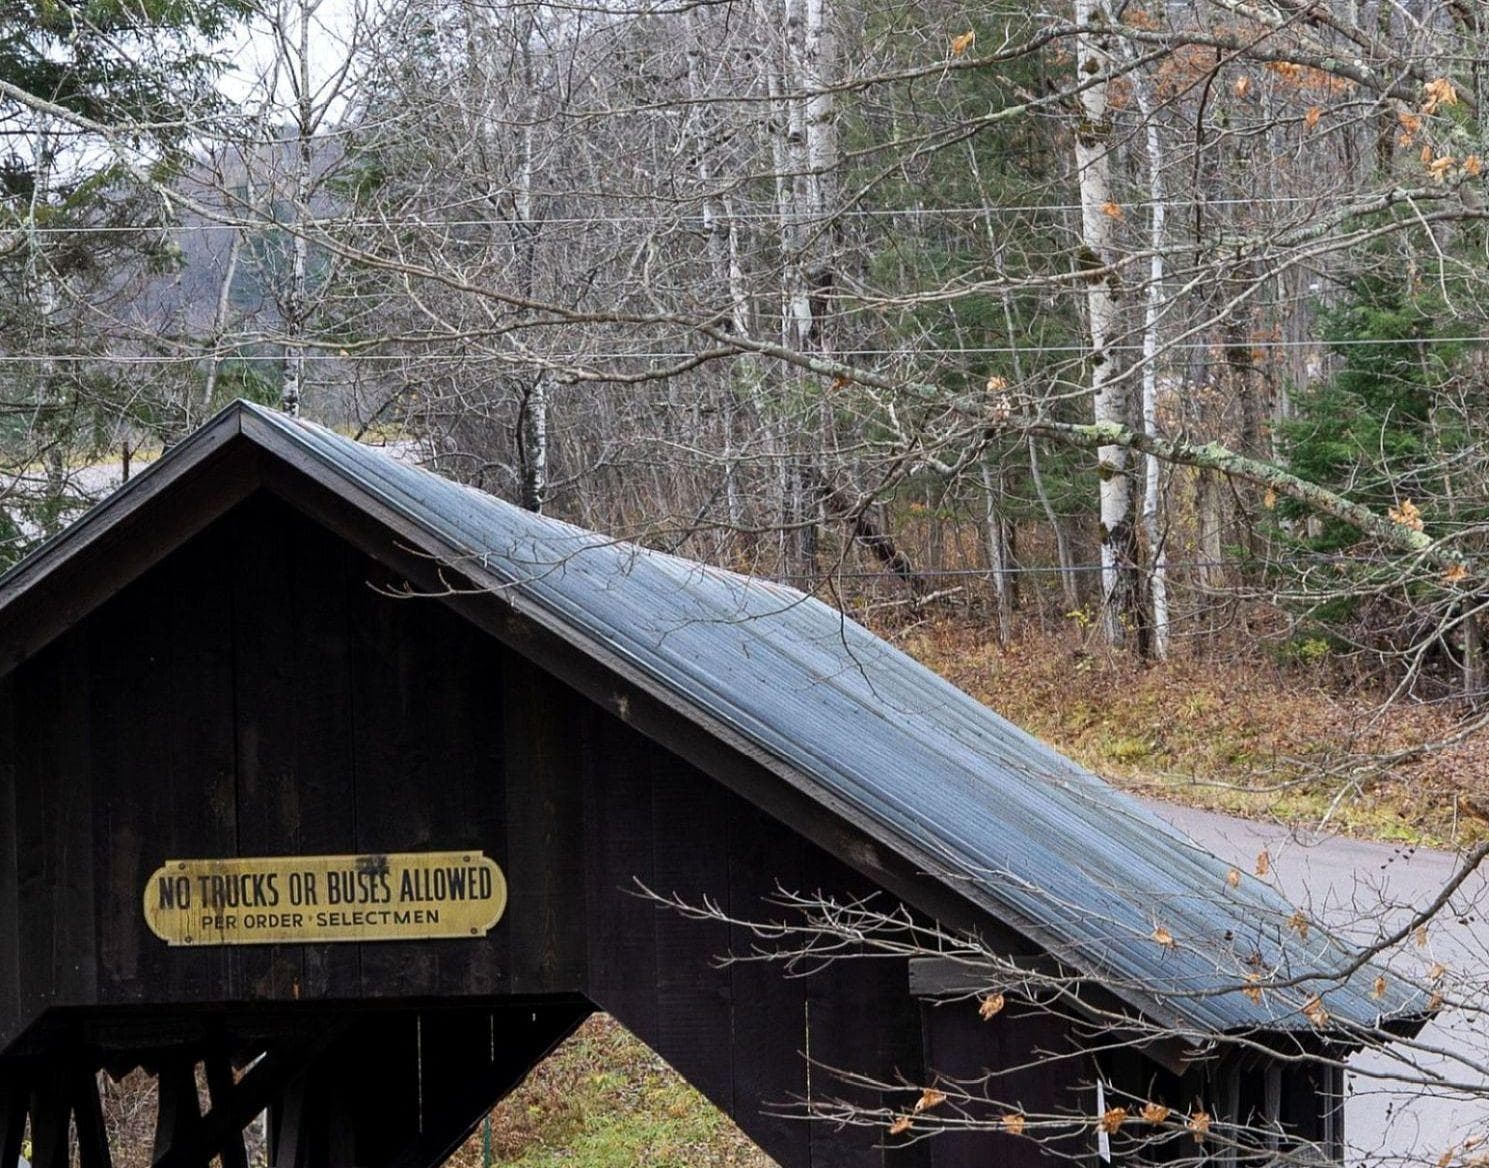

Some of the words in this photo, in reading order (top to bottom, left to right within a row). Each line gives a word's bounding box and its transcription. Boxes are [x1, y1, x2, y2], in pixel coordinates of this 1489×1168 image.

[158, 875, 191, 910] NO
[197, 873, 280, 909] TRUCKS
[288, 871, 319, 906] OR
[327, 868, 392, 905] BUSES
[399, 866, 493, 903] ALLOWED
[202, 914, 237, 930] PER
[243, 913, 303, 929] ORDER
[316, 909, 440, 927] SELECTMEN
